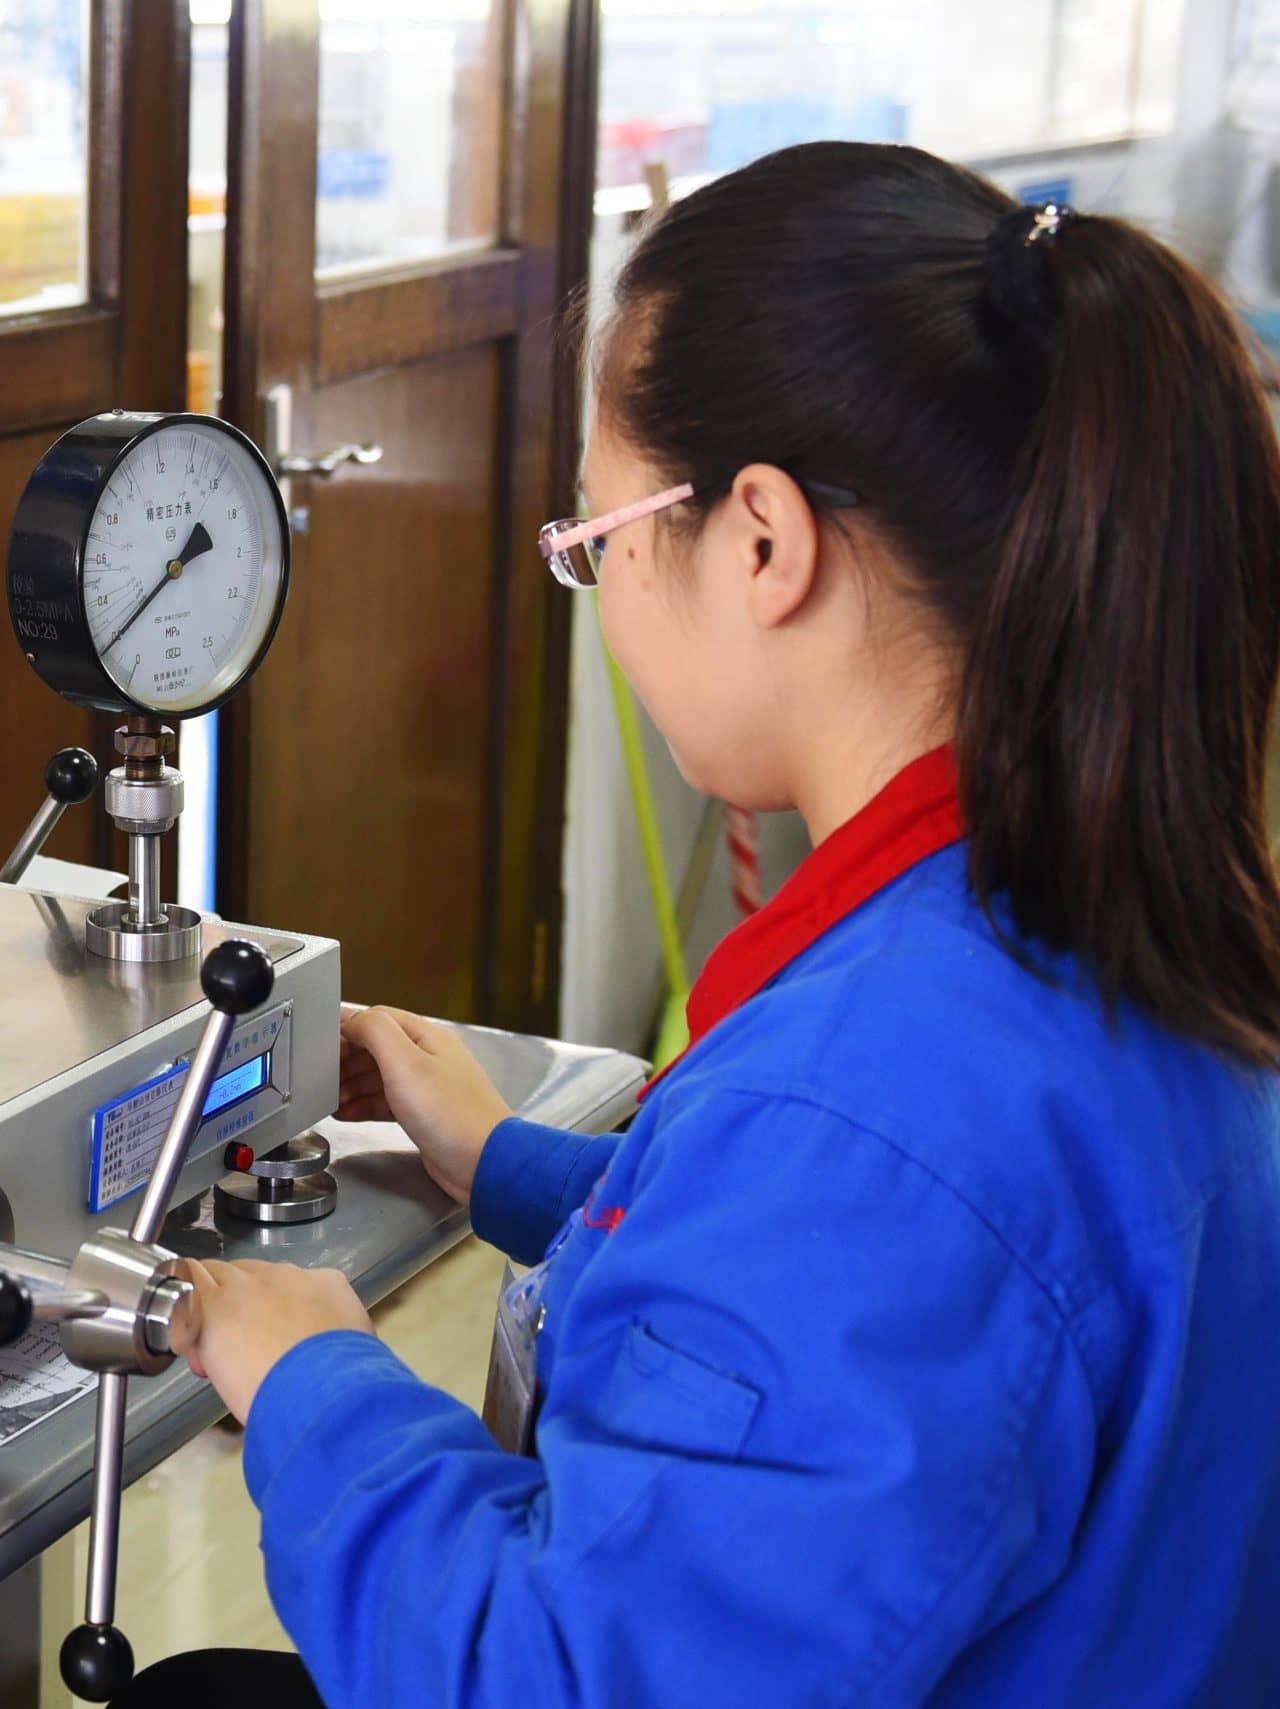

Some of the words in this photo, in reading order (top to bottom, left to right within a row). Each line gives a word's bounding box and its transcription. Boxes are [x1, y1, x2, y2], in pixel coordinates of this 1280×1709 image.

[147, 502, 191, 521] 精密压力表
[106, 513, 118, 525] 0.8
[96, 553, 107, 565] 0.6
[98, 595, 108, 606] 0.4
[202, 636, 213, 648] 2.5
